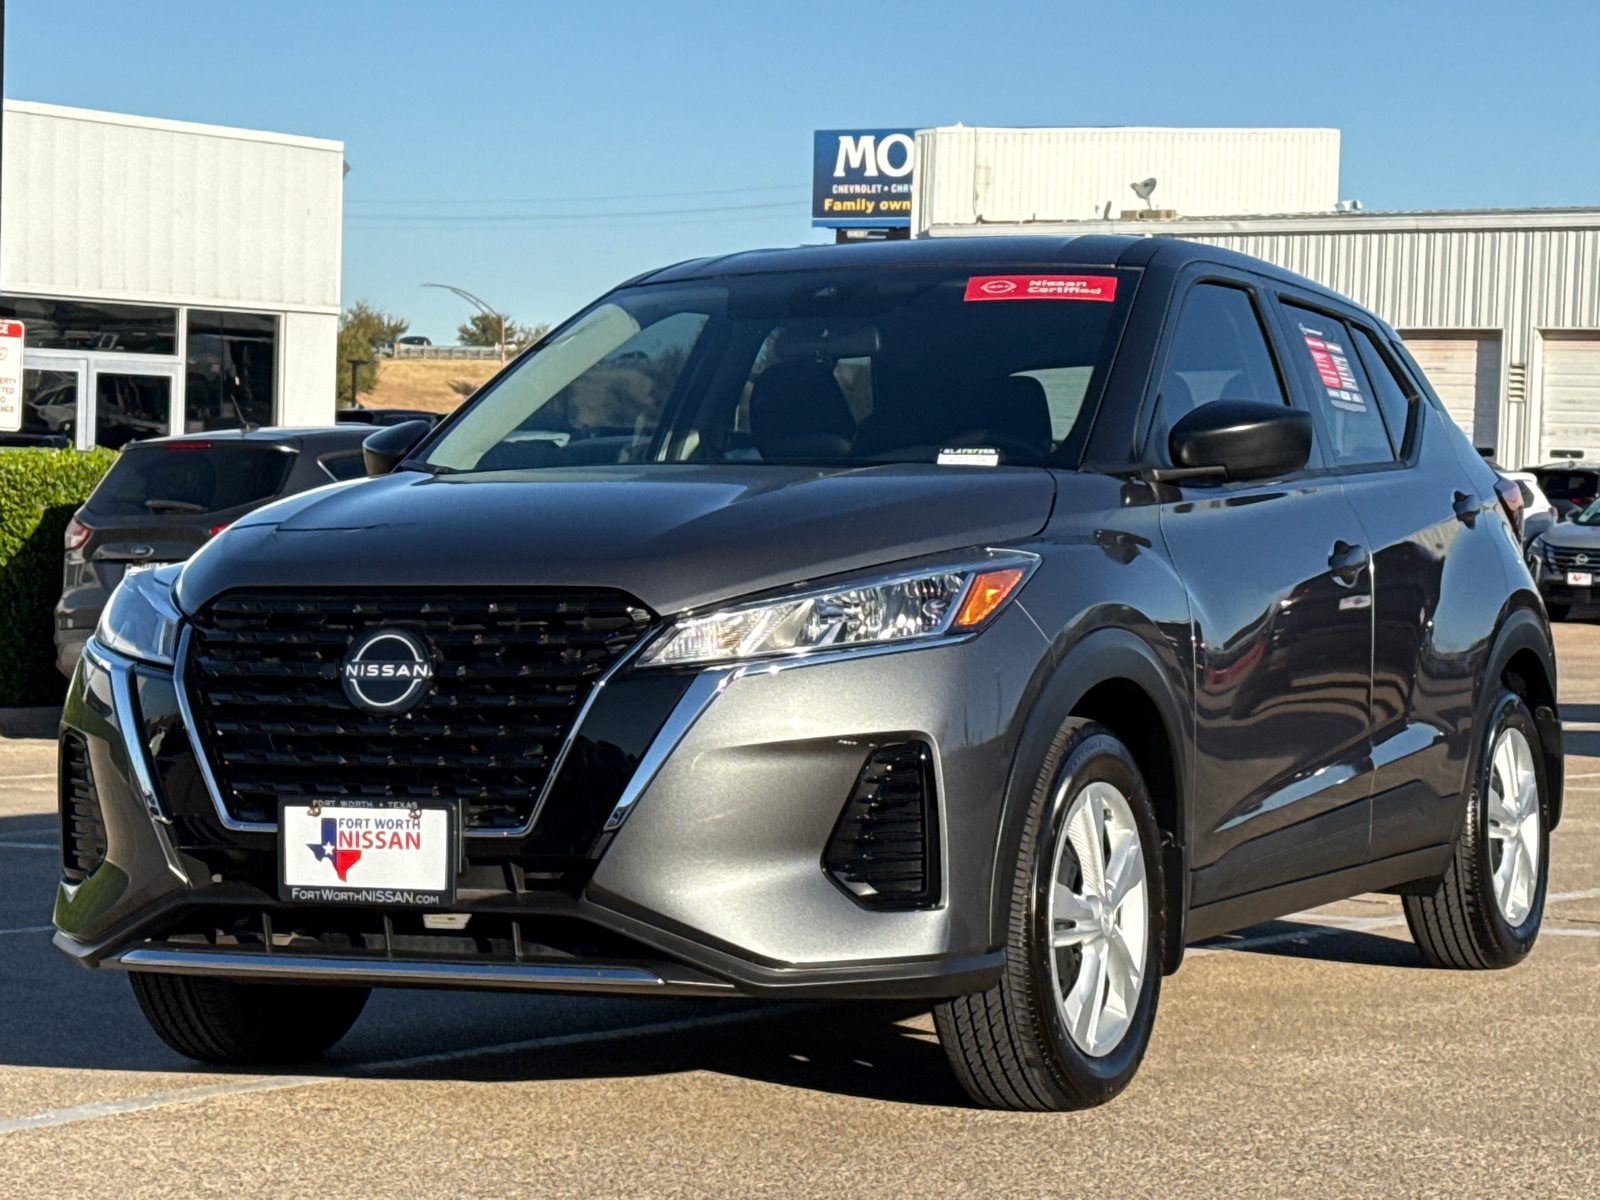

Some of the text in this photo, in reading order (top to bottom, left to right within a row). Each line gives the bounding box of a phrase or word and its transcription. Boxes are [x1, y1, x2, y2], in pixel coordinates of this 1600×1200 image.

[833, 133, 914, 177] MO
[832, 184, 882, 194] CHEVROLET
[824, 198, 911, 214] Family own
[345, 664, 428, 677] NISSAN
[312, 800, 418, 809] FORT WORTH TEXAS
[338, 818, 421, 830] FORT WORTH
[338, 831, 421, 850] NISSAN
